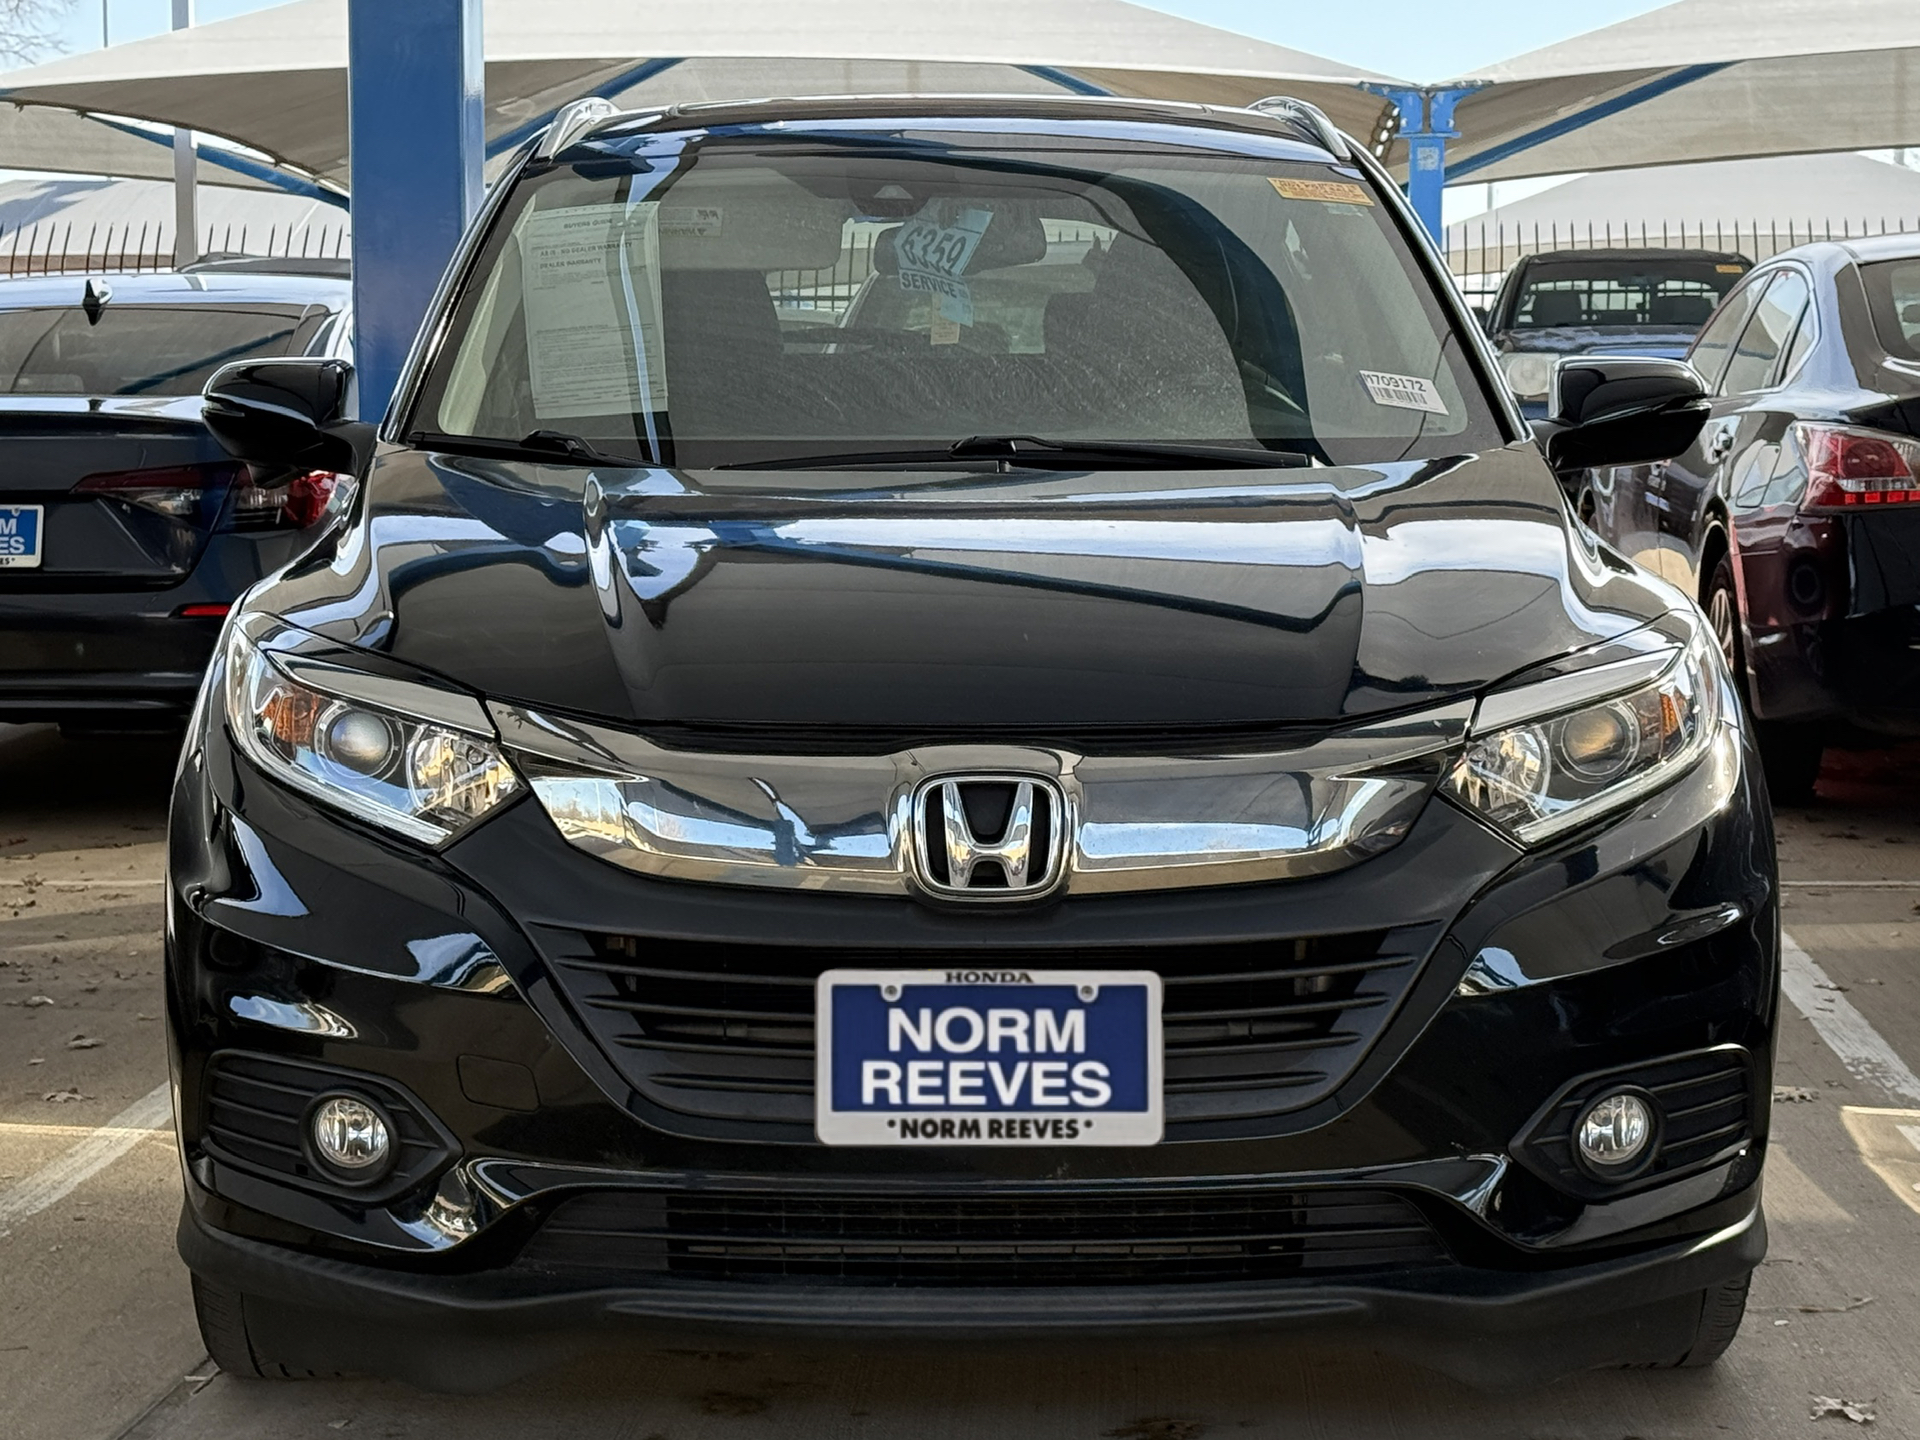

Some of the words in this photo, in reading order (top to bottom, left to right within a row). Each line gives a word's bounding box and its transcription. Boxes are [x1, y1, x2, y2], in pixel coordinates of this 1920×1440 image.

[902, 226, 967, 277] 6359
[902, 272, 957, 299] SERVICE
[945, 971, 1034, 984] HONDA
[889, 1007, 1086, 1053] NORM
[862, 1060, 1112, 1107] REEVES
[901, 1119, 981, 1139] NORM
[988, 1119, 1079, 1139] REEVES
